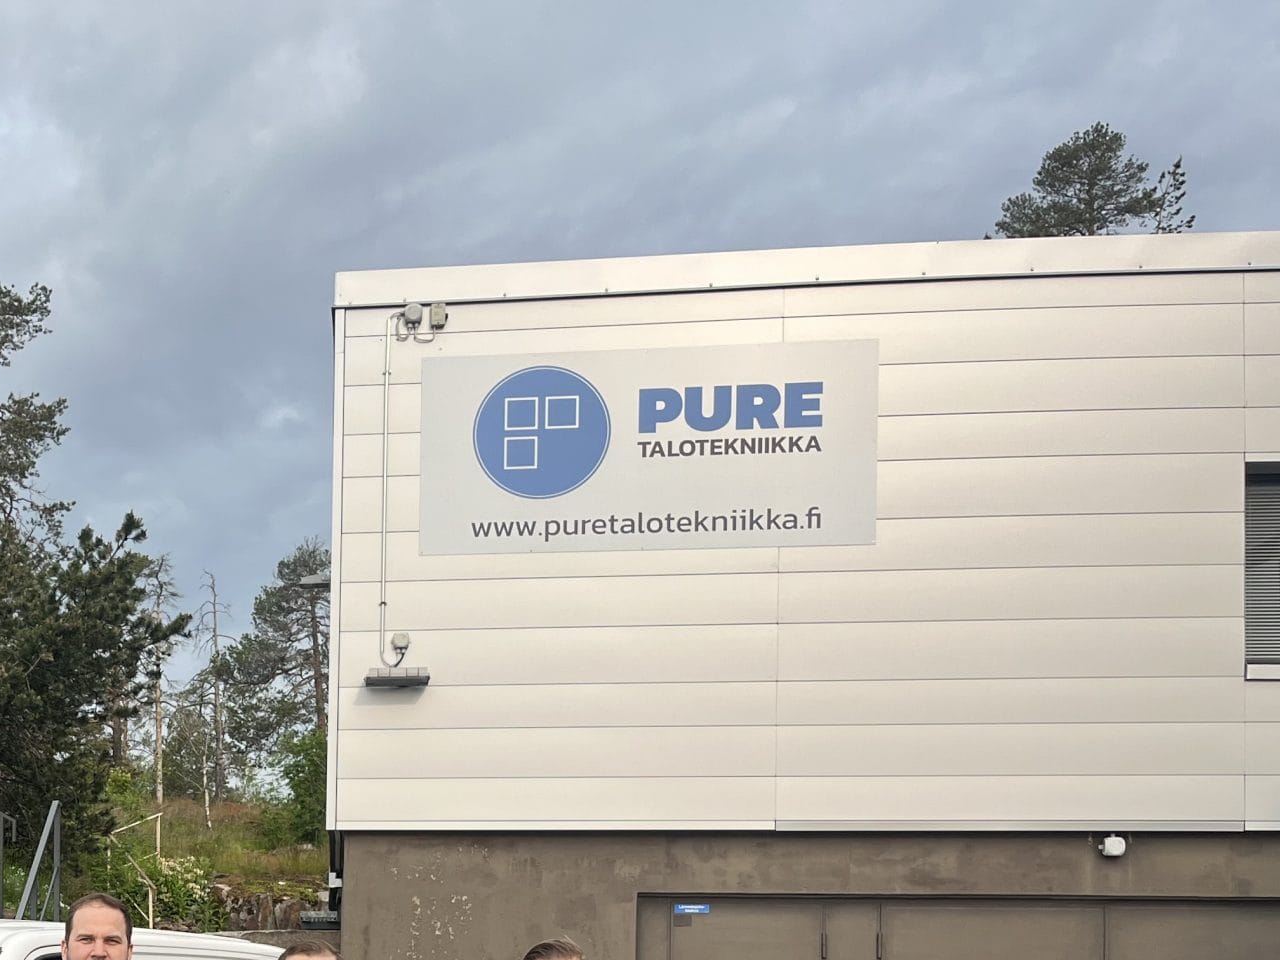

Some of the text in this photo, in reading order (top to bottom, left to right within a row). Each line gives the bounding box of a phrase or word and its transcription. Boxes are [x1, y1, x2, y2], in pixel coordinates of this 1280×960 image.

[638, 381, 824, 434] PURE
[637, 435, 822, 458] TALOTEKNIIKKA
[471, 506, 822, 542] www.puretalotekniikka.fi
